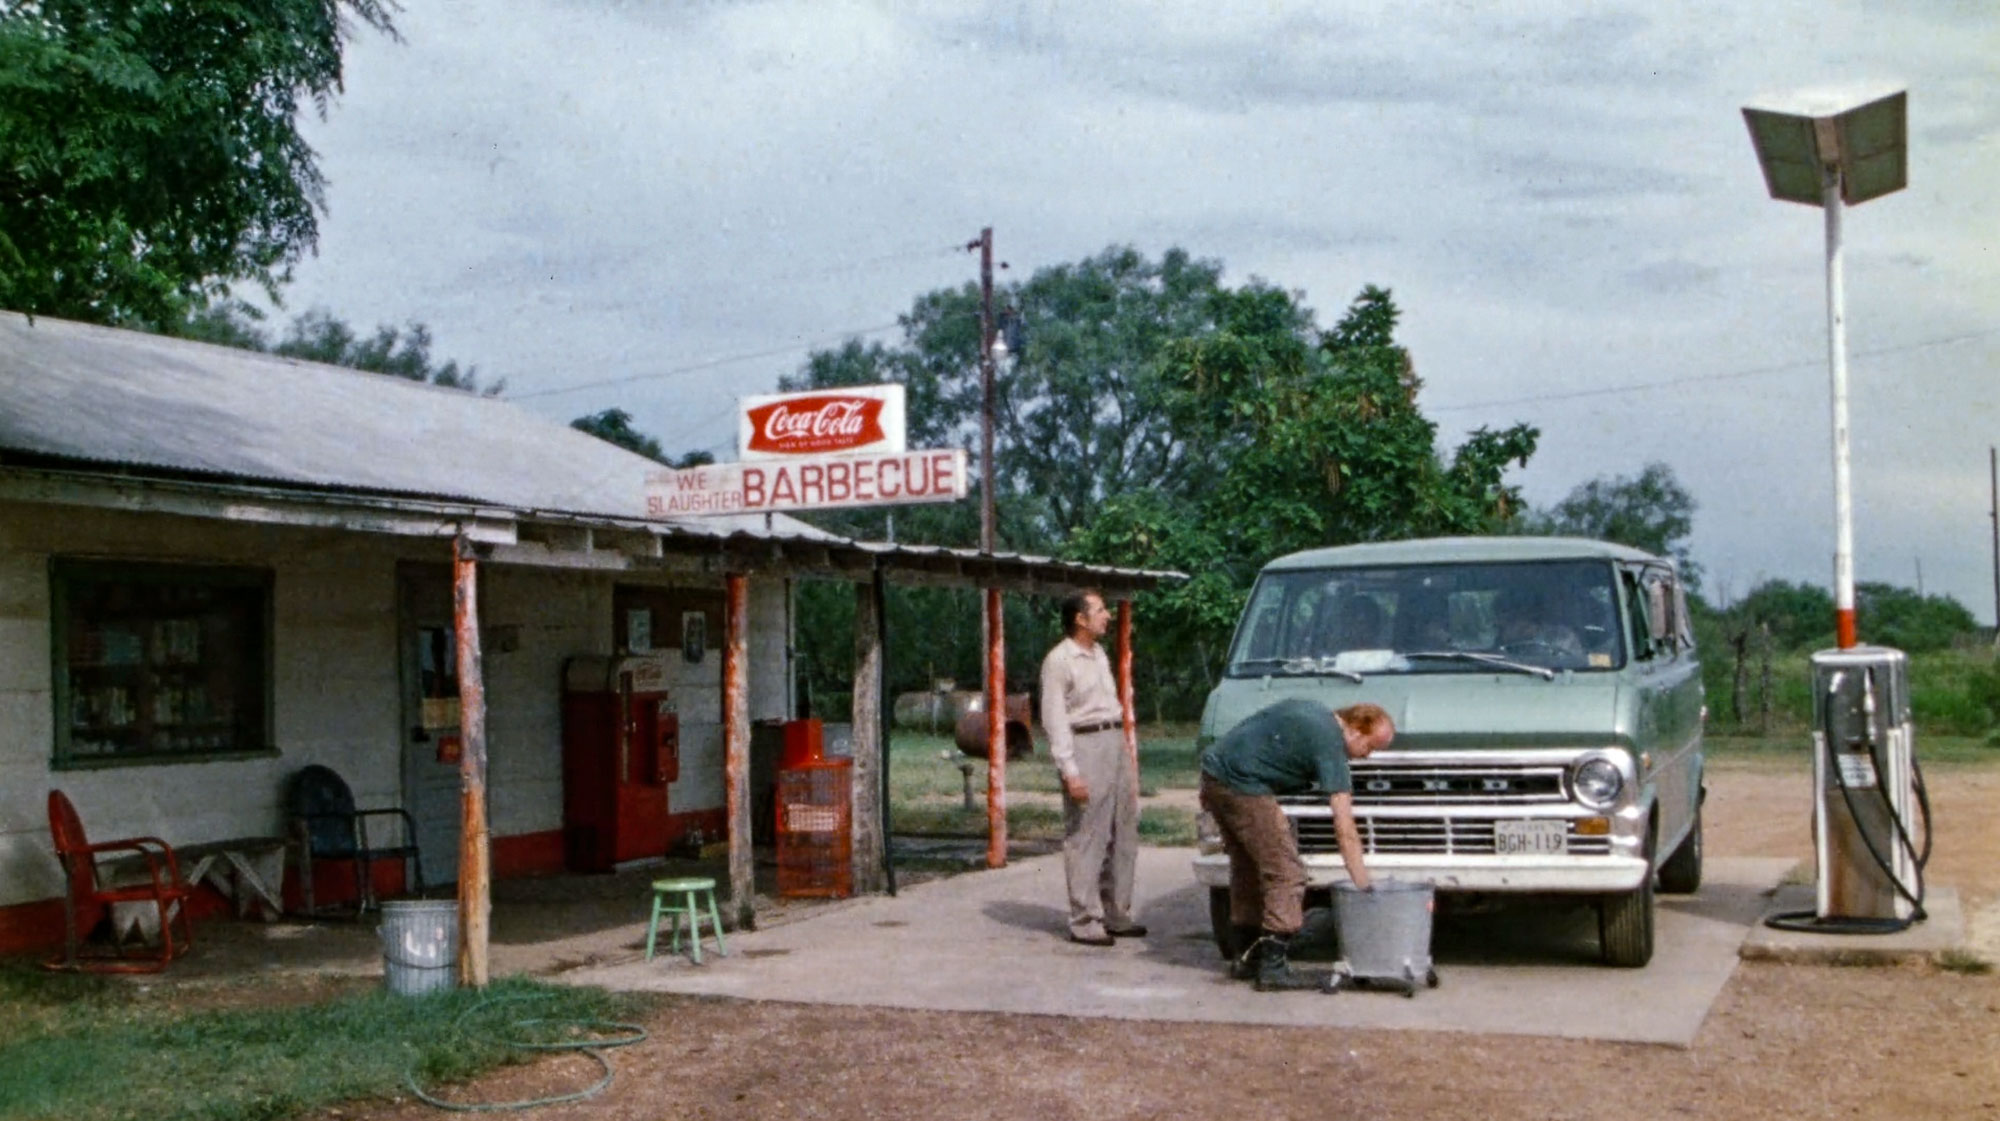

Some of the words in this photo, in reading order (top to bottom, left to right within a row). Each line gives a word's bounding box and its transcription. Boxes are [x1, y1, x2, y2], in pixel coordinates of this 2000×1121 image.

[765, 400, 867, 440] Coca-Cola
[677, 472, 707, 491] WE
[743, 455, 952, 507] BARBECUE
[648, 490, 742, 514] SLAUGHTER
